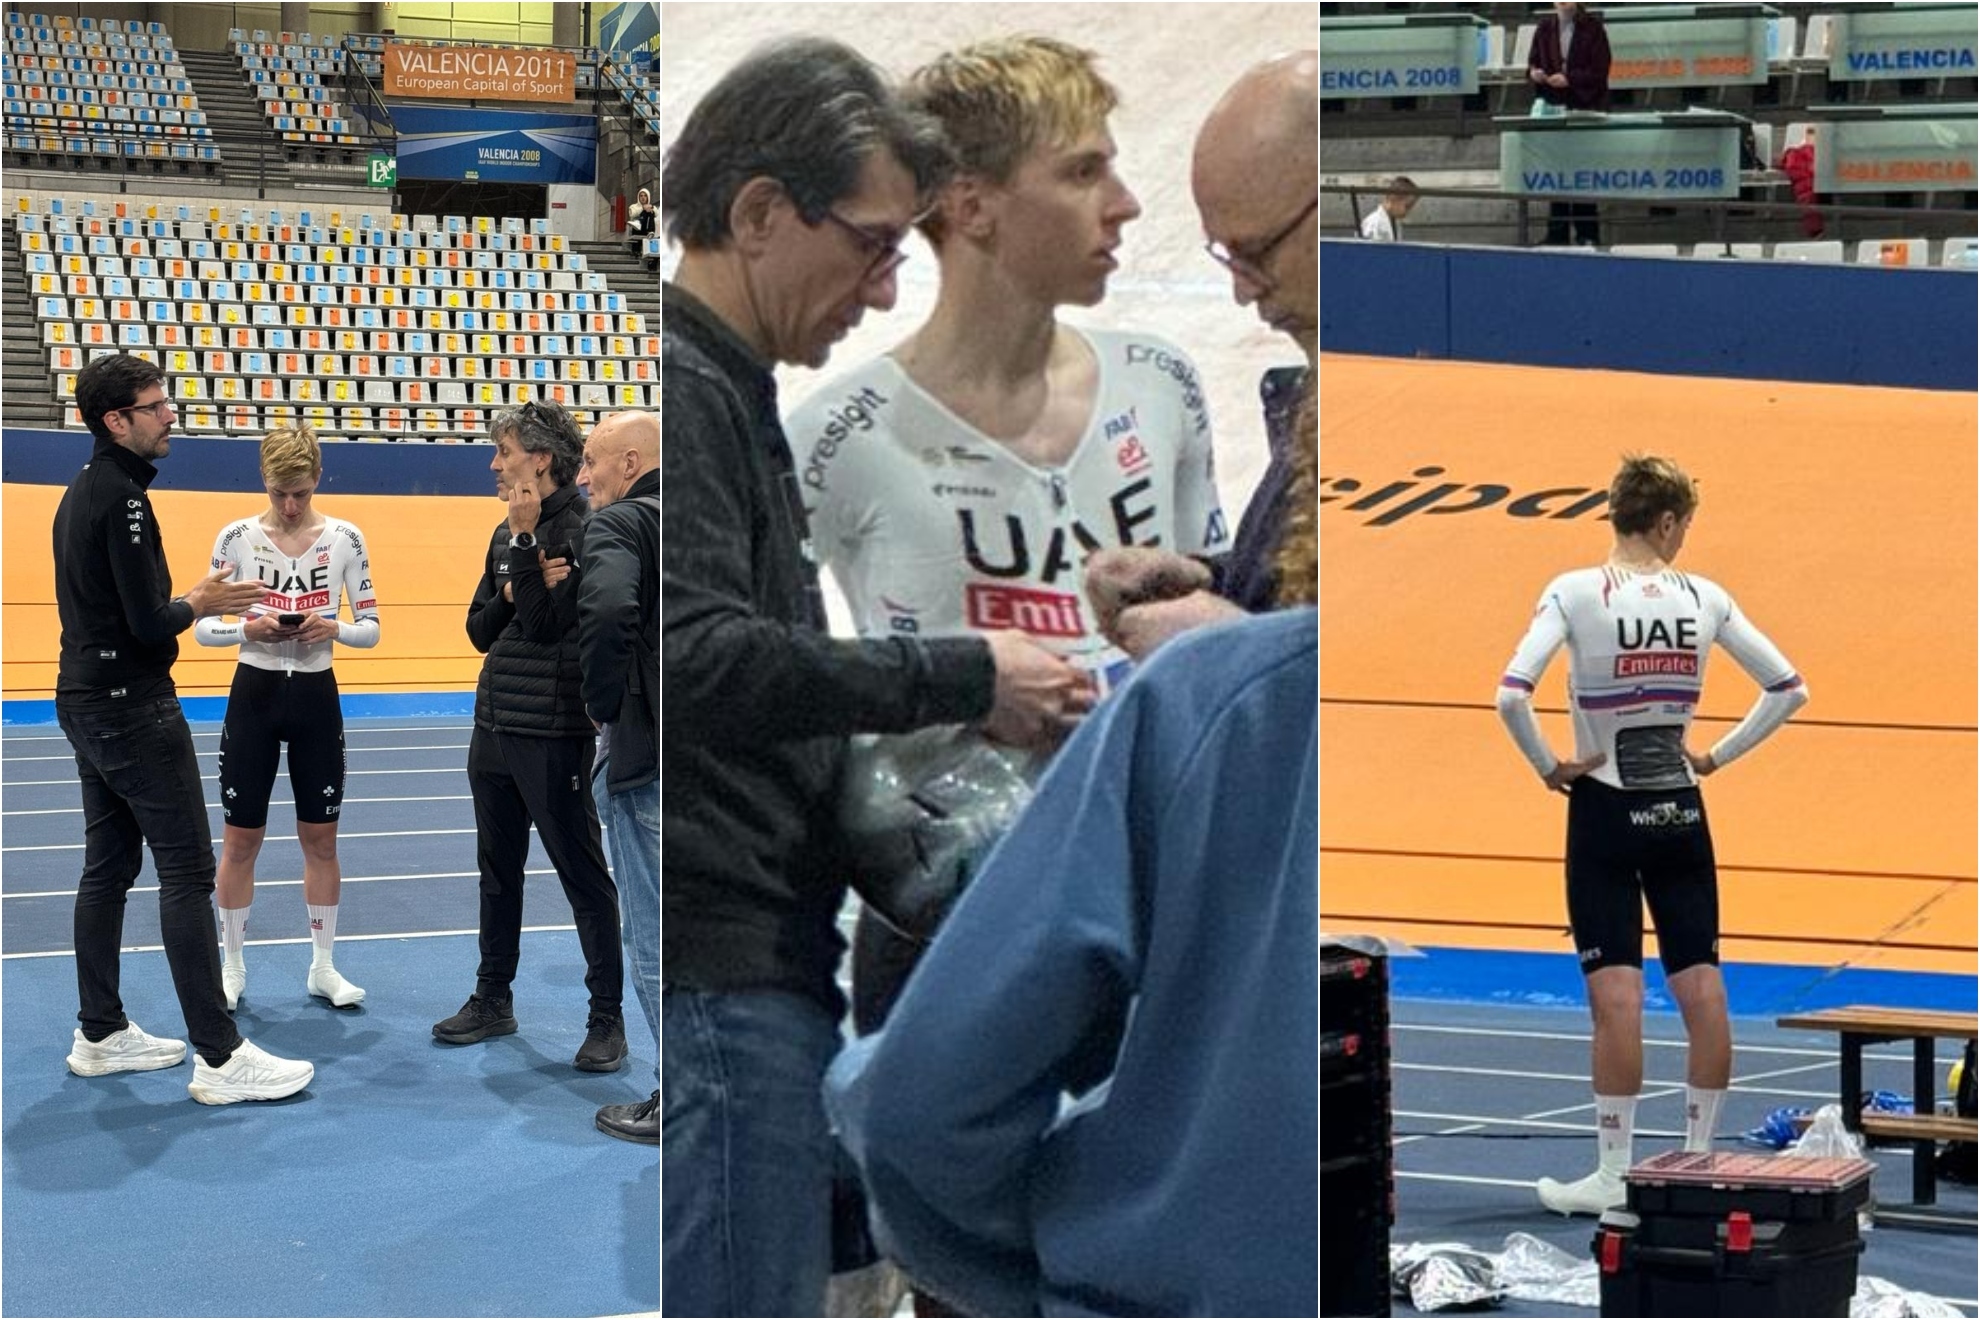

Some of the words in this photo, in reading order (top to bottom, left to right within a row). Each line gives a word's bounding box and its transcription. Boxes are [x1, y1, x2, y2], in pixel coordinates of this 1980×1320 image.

[397, 50, 510, 76] VALENCIA
[514, 55, 565, 78] 2011
[1846, 48, 1975, 72] VALENCIA
[396, 75, 459, 92] European
[463, 77, 508, 93] Capital
[512, 81, 526, 93] of
[530, 80, 563, 95] Sport
[1320, 68, 1399, 90] ENCIA
[1406, 66, 1462, 87] 2008
[478, 147, 519, 160] VALENCIA
[520, 149, 541, 162] 2008
[1523, 168, 1656, 191] VALENCIA
[1664, 168, 1724, 189] 2008
[803, 386, 889, 492] presight
[220, 523, 250, 556] presight
[335, 525, 363, 557] presight
[957, 478, 1160, 583] UAE
[259, 565, 328, 594] UAE
[263, 594, 329, 612] mirates
[1617, 617, 1697, 649] UAE
[1619, 654, 1697, 677] Emirates
